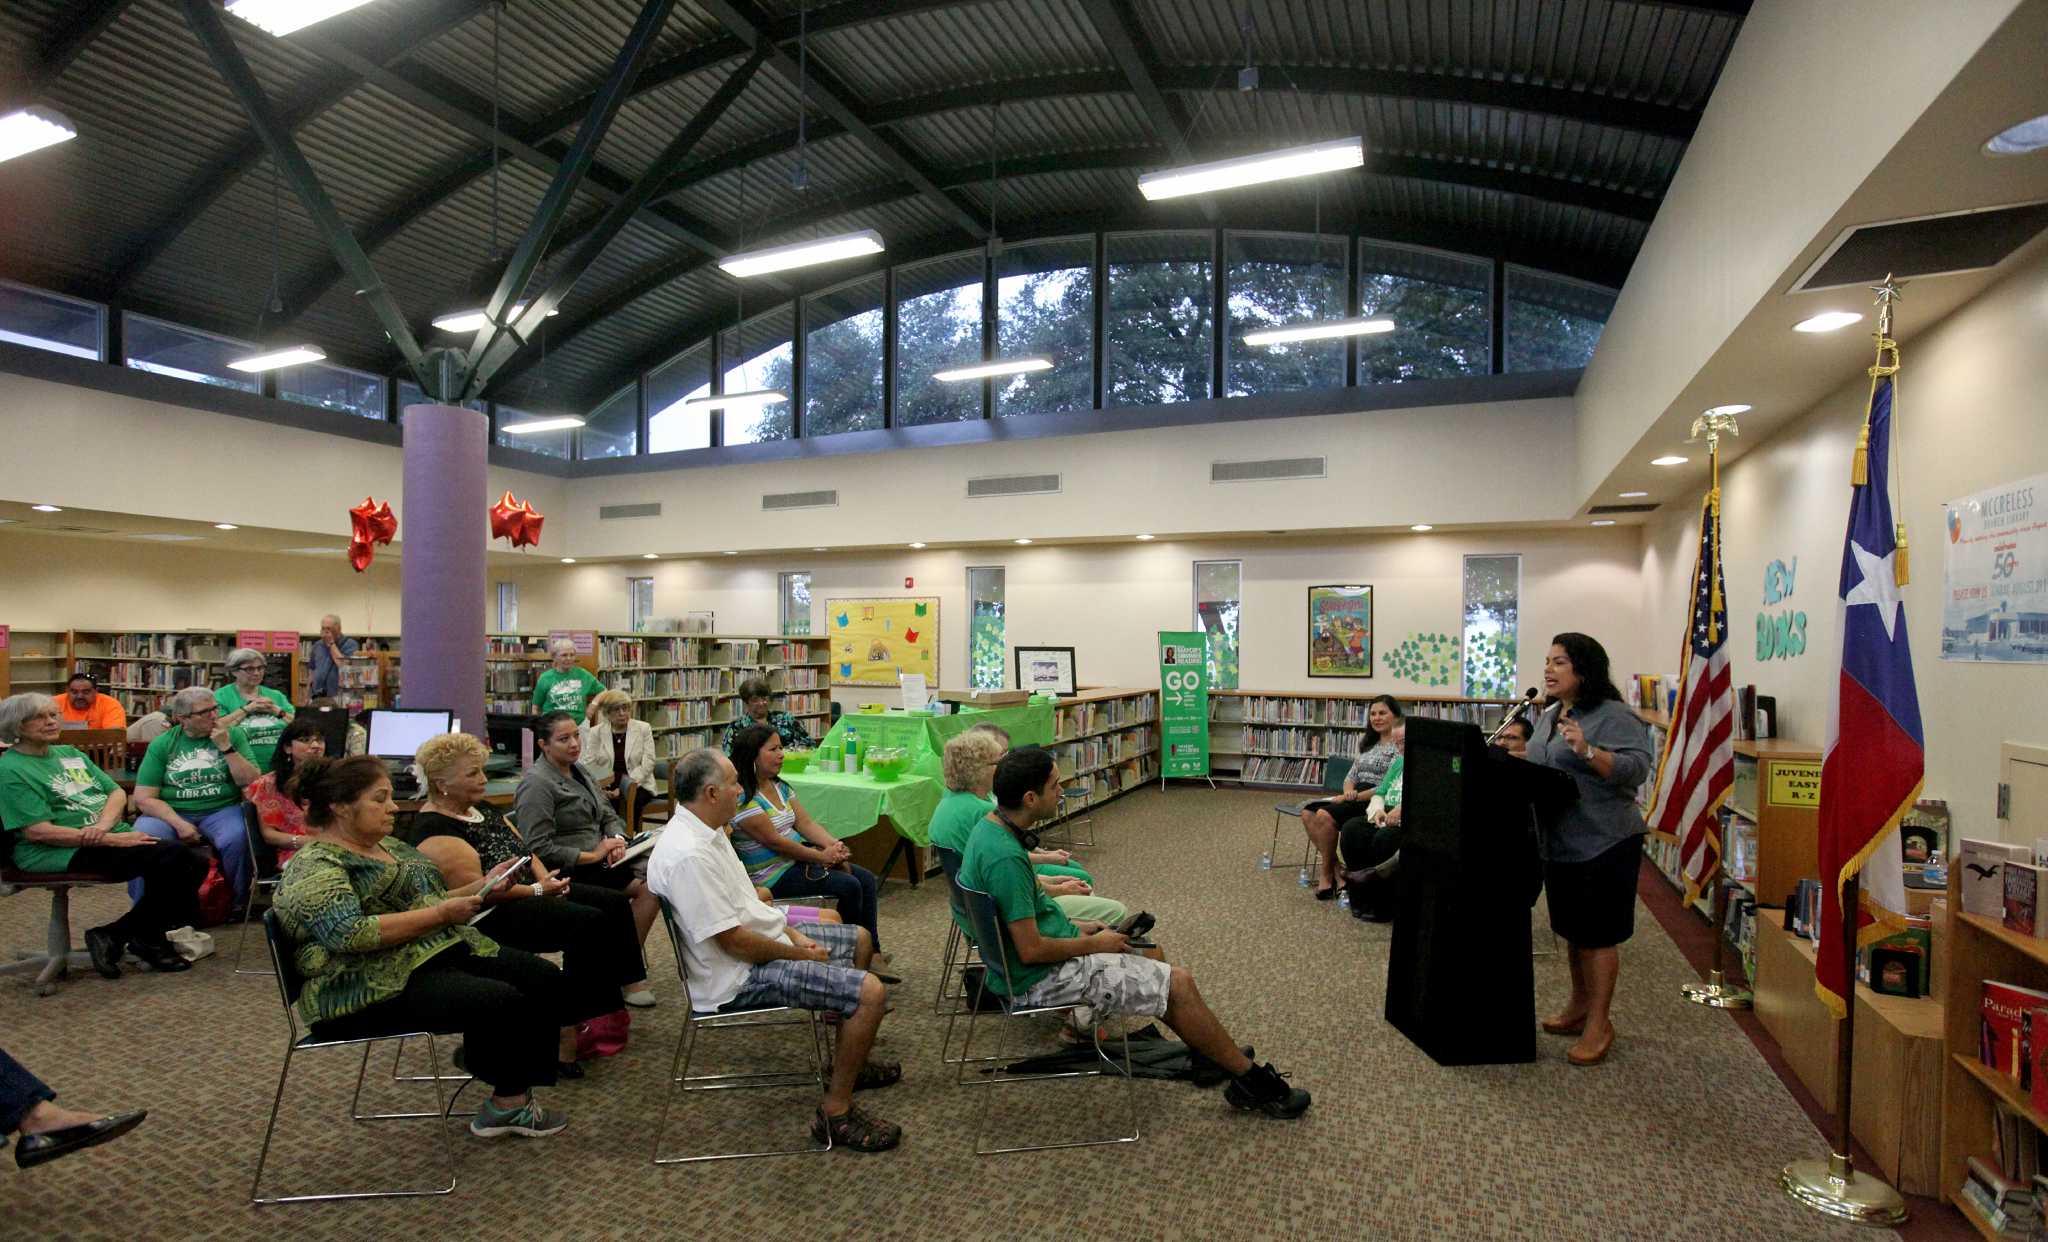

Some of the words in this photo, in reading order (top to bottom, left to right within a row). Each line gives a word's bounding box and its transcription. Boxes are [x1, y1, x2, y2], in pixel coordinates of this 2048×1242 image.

[1992, 551, 2016, 580] 50
[1763, 556, 1798, 605] NEW
[1756, 610, 1807, 662] BOOKS
[1166, 671, 1200, 691] GO
[1775, 769, 1822, 778] JUVENI
[176, 787, 221, 799] LIBRARY
[1984, 997, 2023, 1018] Parad
